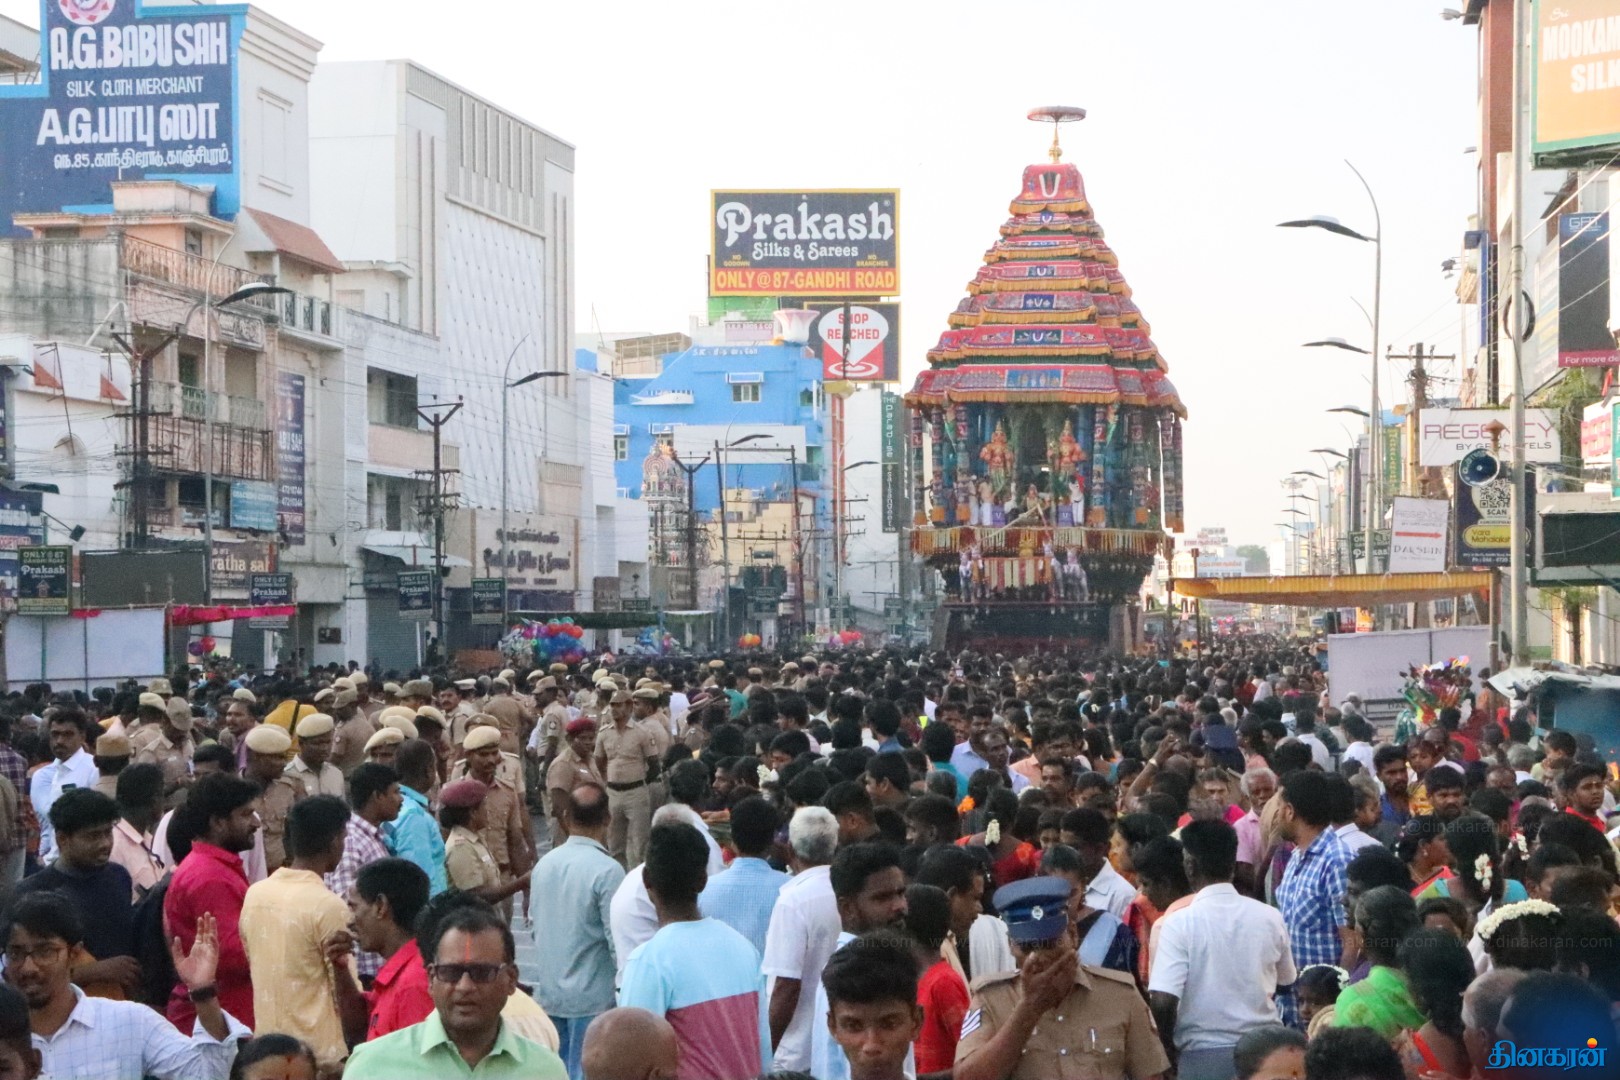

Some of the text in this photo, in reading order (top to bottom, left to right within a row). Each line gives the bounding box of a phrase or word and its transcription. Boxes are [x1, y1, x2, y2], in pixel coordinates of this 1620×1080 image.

[66, 75, 204, 98] SILK CLOTH MERCHANT
[716, 201, 894, 248] Prakash
[752, 242, 859, 261] Silks & Sarees
[716, 271, 755, 288] ONLY
[757, 271, 771, 289] @
[855, 271, 895, 288] ROAD
[827, 328, 880, 340] RECHED
[1424, 423, 1556, 440] REGECY
[1456, 443, 1470, 451] BY
[21, 565, 66, 575] Prakash
[253, 587, 287, 597] Prakash
